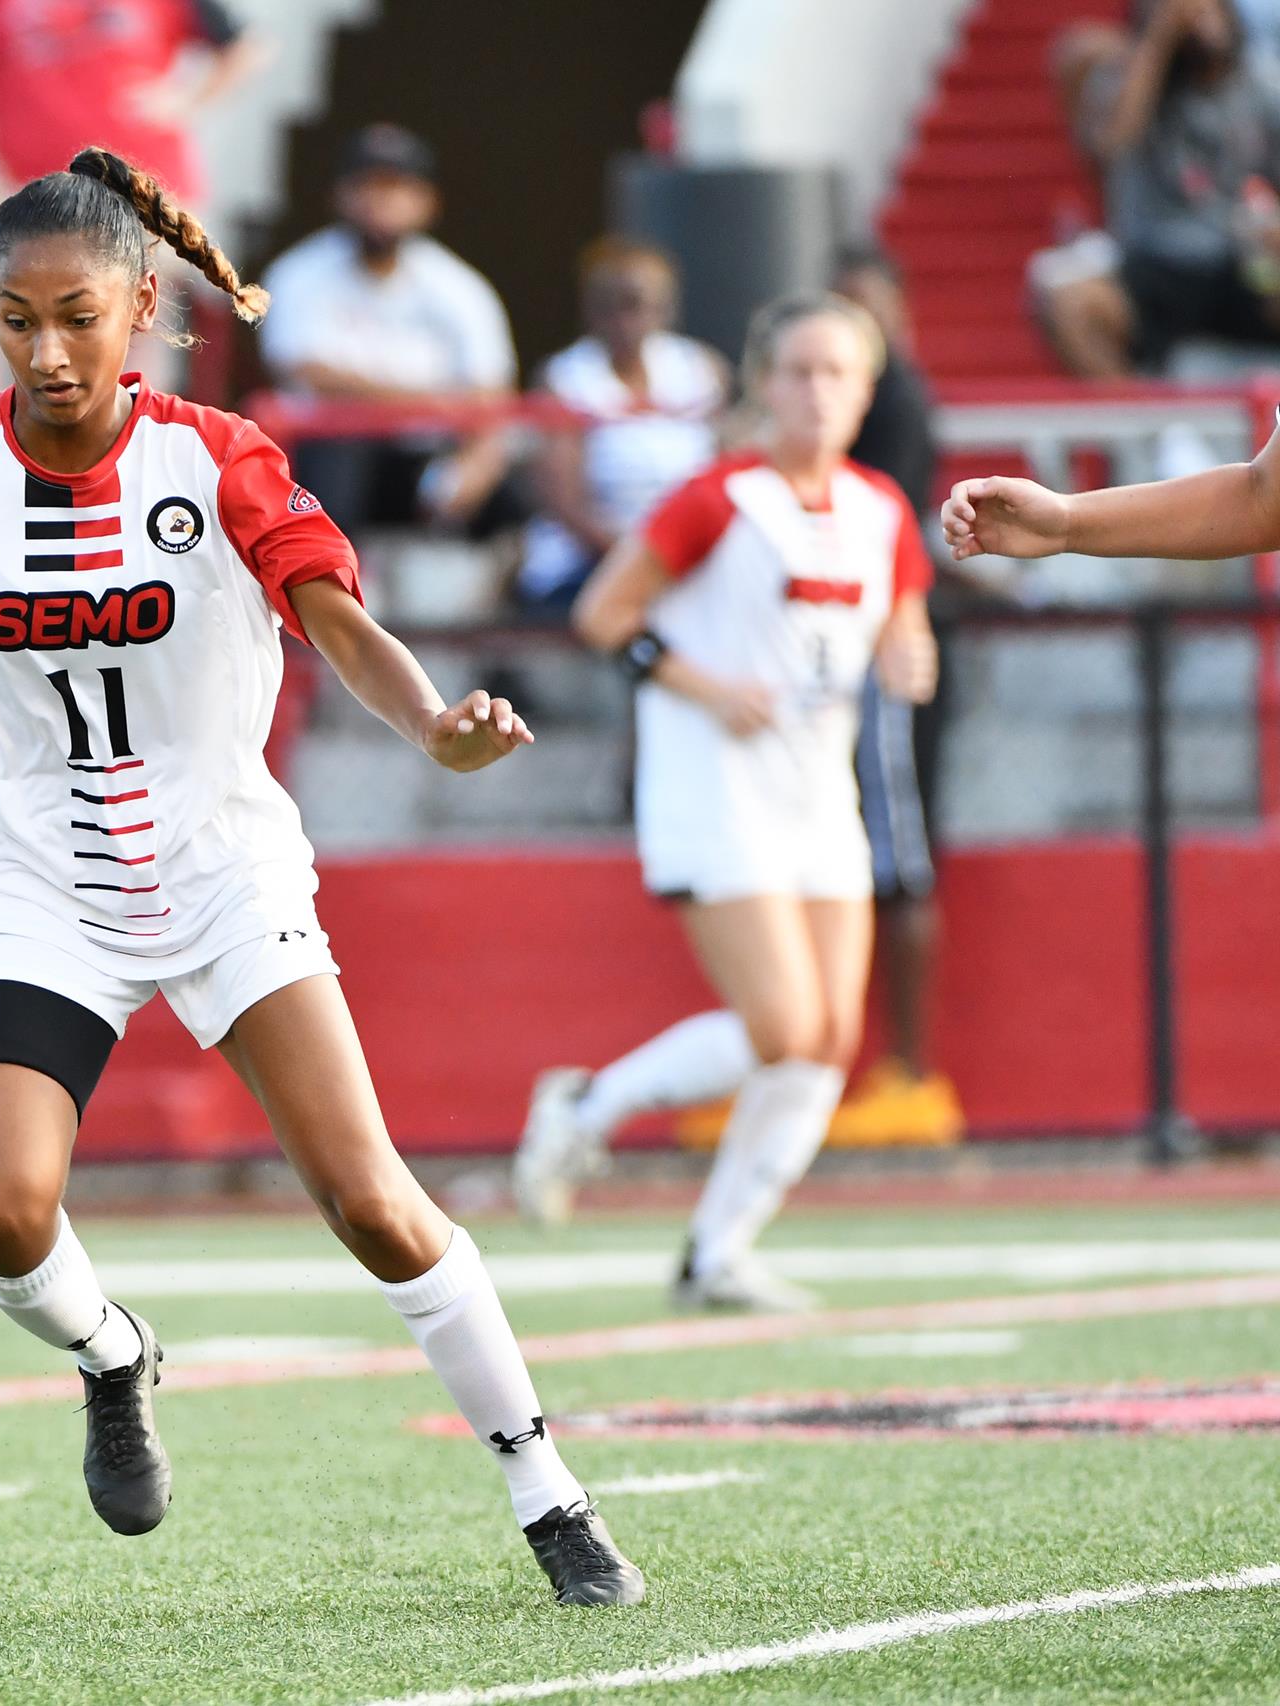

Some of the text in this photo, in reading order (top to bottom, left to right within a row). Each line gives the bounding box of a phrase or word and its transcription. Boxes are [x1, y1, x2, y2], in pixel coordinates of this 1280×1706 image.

[156, 540, 178, 552] United
[179, 544, 189, 552] As
[45, 666, 135, 760] 11
